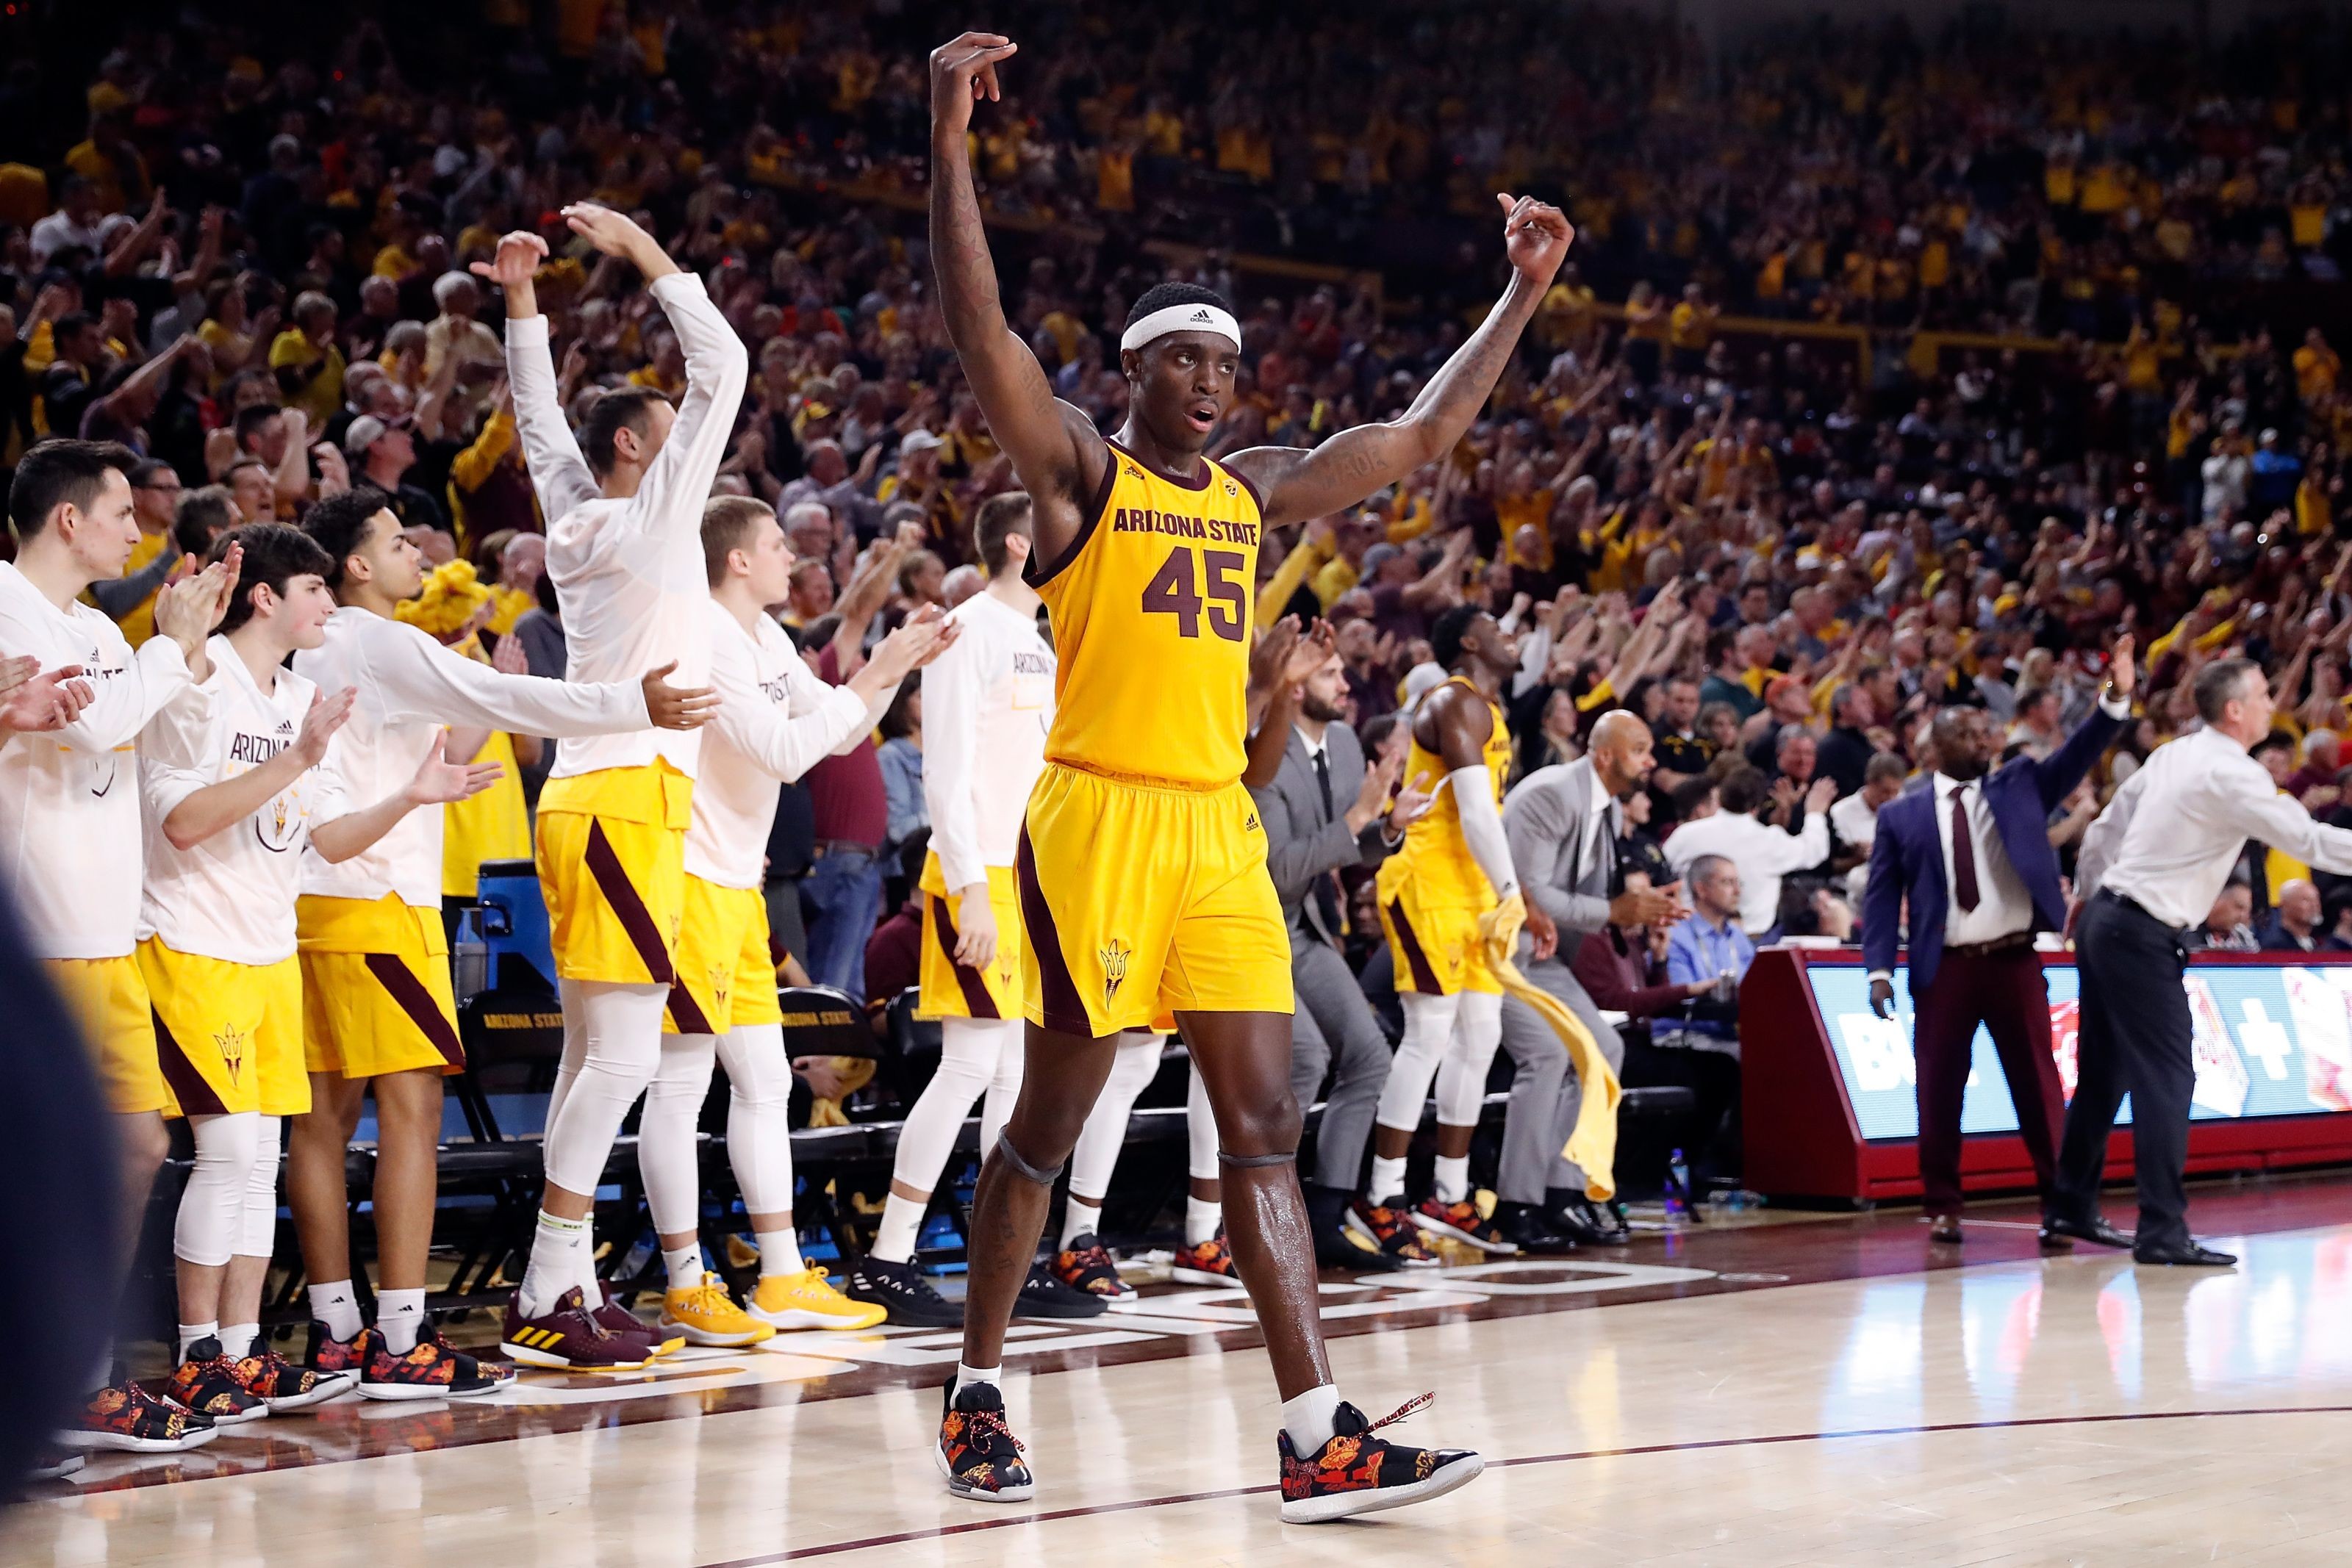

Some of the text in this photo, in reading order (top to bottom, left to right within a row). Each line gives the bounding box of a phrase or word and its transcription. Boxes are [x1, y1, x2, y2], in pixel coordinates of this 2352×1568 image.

[1113, 508, 1257, 547] ARIZONA STATE
[1141, 546, 1246, 642] 45
[1286, 1470, 1313, 1499] 13
